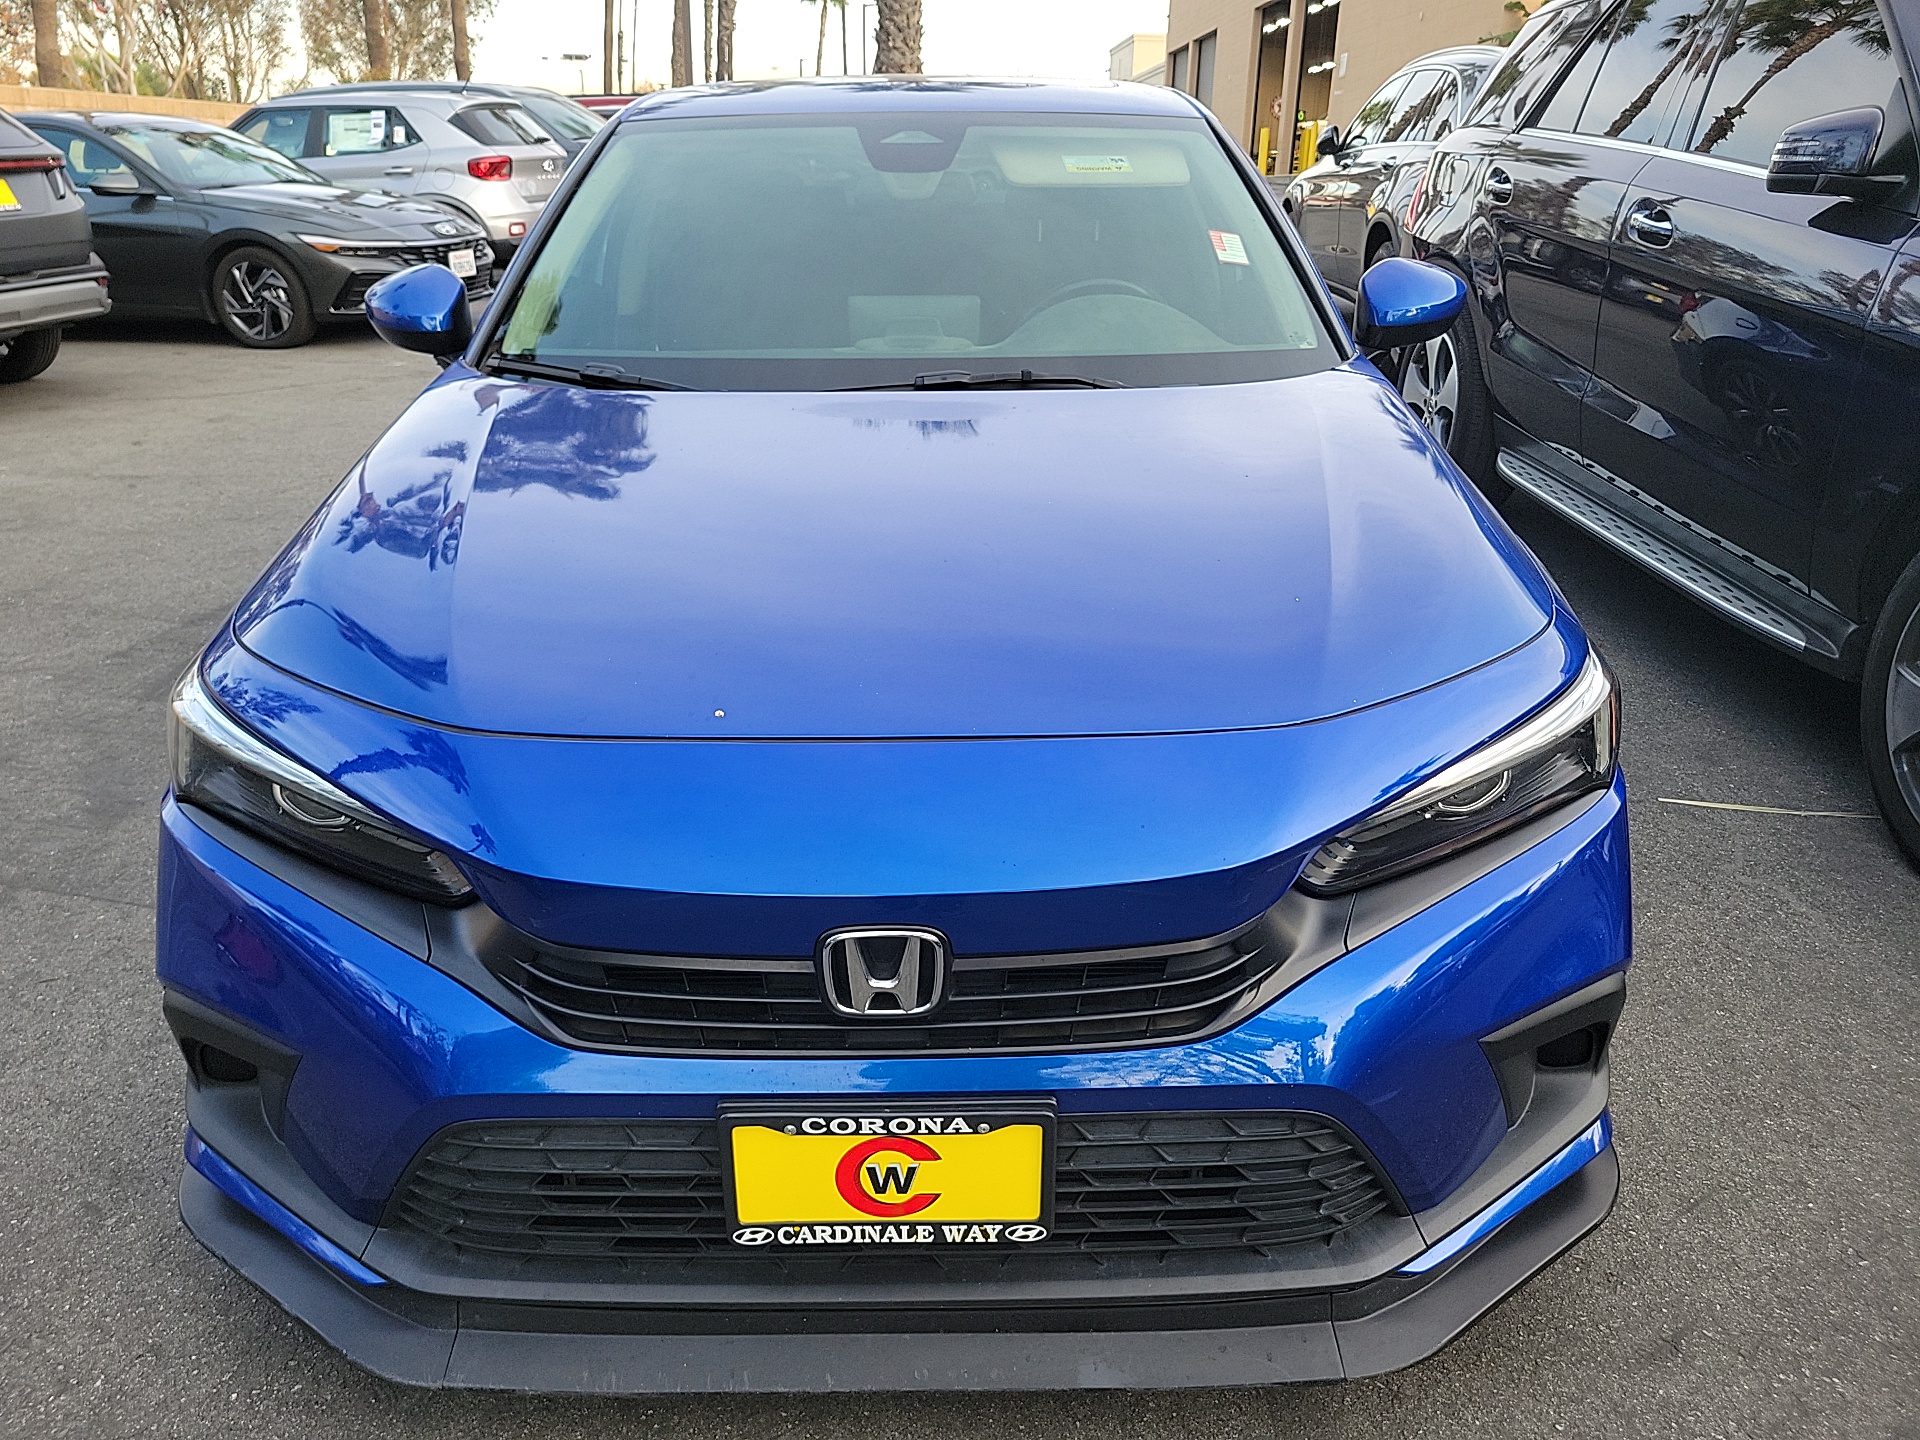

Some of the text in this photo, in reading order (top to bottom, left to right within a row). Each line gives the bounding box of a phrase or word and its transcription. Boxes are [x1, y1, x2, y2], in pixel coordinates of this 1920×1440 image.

[801, 1117, 974, 1135] CORONA
[866, 1162, 920, 1195] W
[777, 1224, 1003, 1245] CARDINALE WAY
